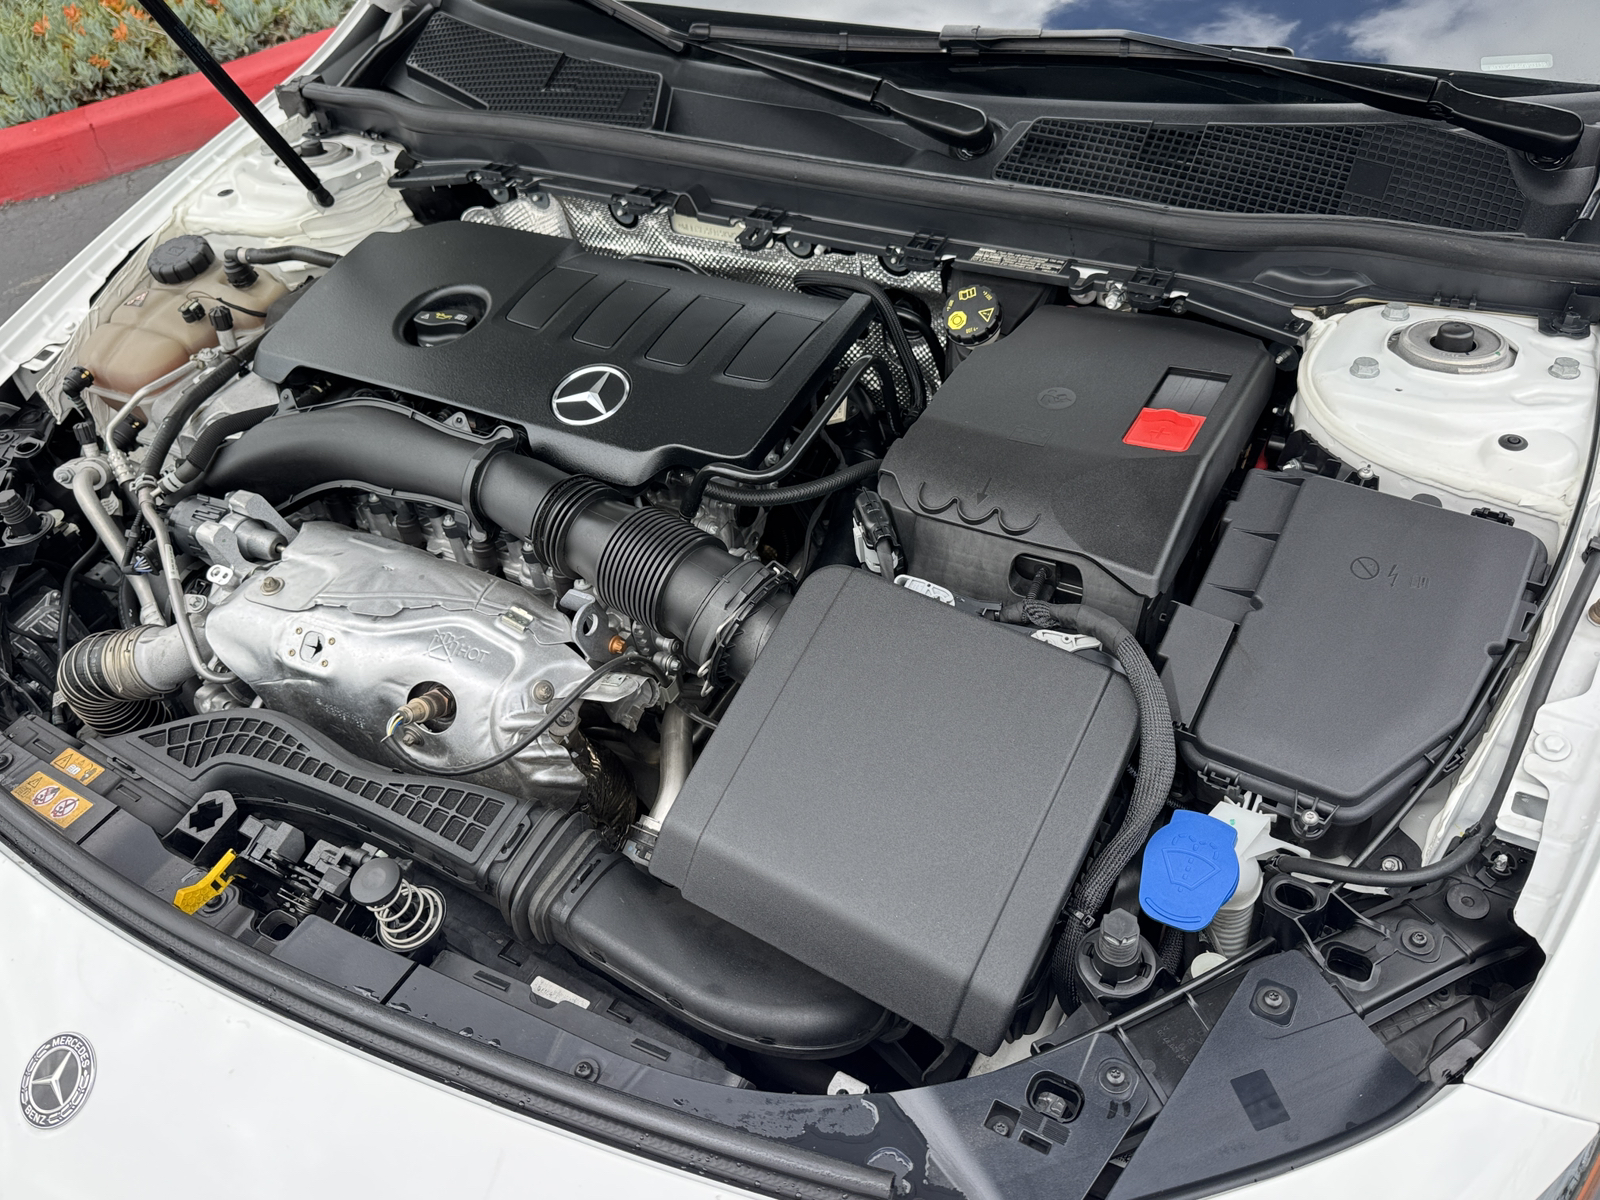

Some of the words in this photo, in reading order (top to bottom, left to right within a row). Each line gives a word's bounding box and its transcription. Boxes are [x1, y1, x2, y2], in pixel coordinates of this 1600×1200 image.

[457, 643, 491, 663] HOT
[52, 1036, 90, 1068] MERCEDES
[25, 1104, 47, 1125] BENZ
